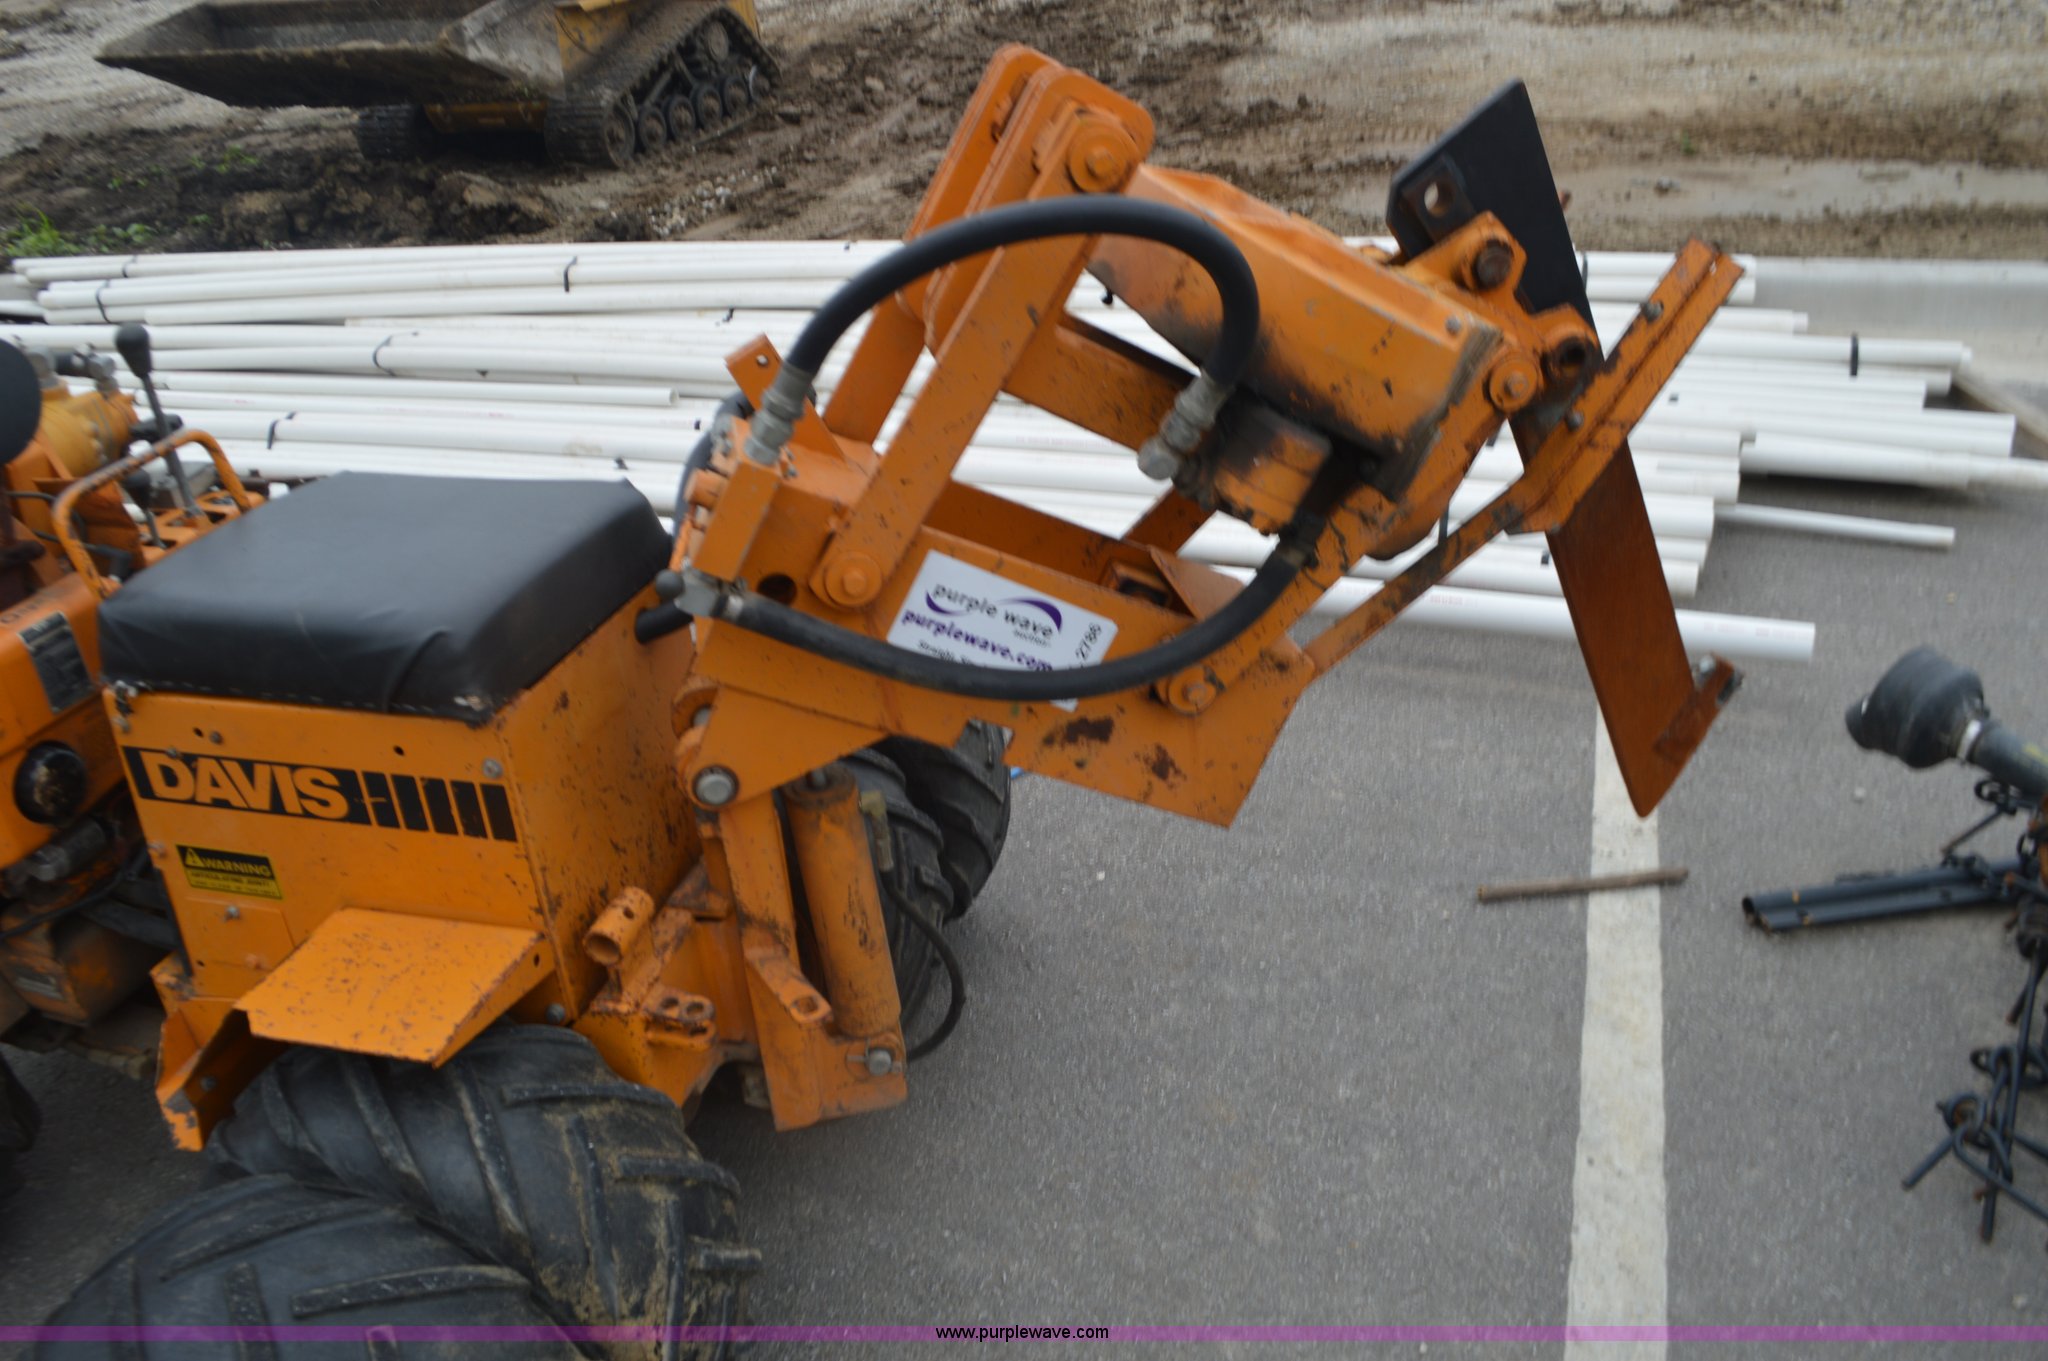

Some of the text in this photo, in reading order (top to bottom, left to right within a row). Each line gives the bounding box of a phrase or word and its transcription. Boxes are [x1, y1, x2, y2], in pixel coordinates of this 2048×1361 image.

[932, 583, 1053, 638] purple wave
[139, 751, 350, 820] DAVIS
[202, 857, 271, 877] WARNING
